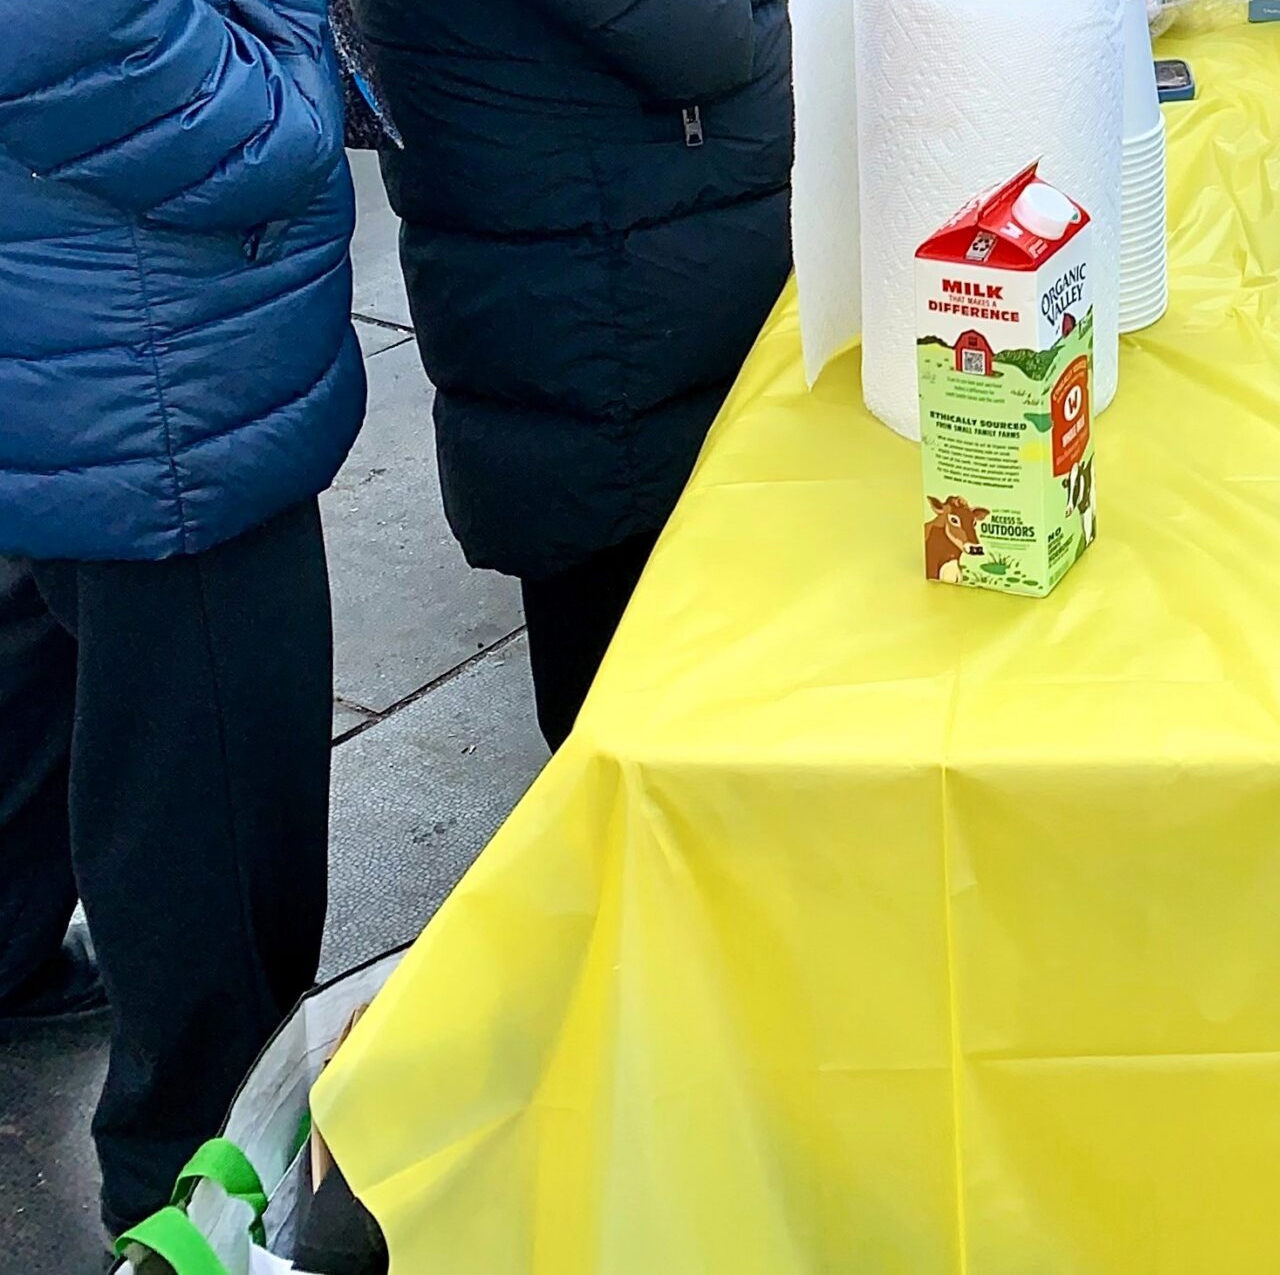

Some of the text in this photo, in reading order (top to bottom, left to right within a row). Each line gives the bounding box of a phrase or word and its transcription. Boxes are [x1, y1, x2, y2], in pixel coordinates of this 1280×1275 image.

[942, 278, 1004, 300] MILK
[1041, 262, 1087, 316] ORGANIC
[948, 294, 997, 308] THAT MAKES A
[1046, 282, 1084, 327] VALLEY
[928, 299, 1020, 323] DIFFERENCE
[929, 410, 1027, 431] ETHICALLY SOURCED
[936, 421, 1020, 439] FROM SMALL FAMILY FARMS
[980, 522, 1035, 537] OUTDOORS
[991, 515, 1015, 525] ACCESS
[1047, 526, 1062, 543] NO
